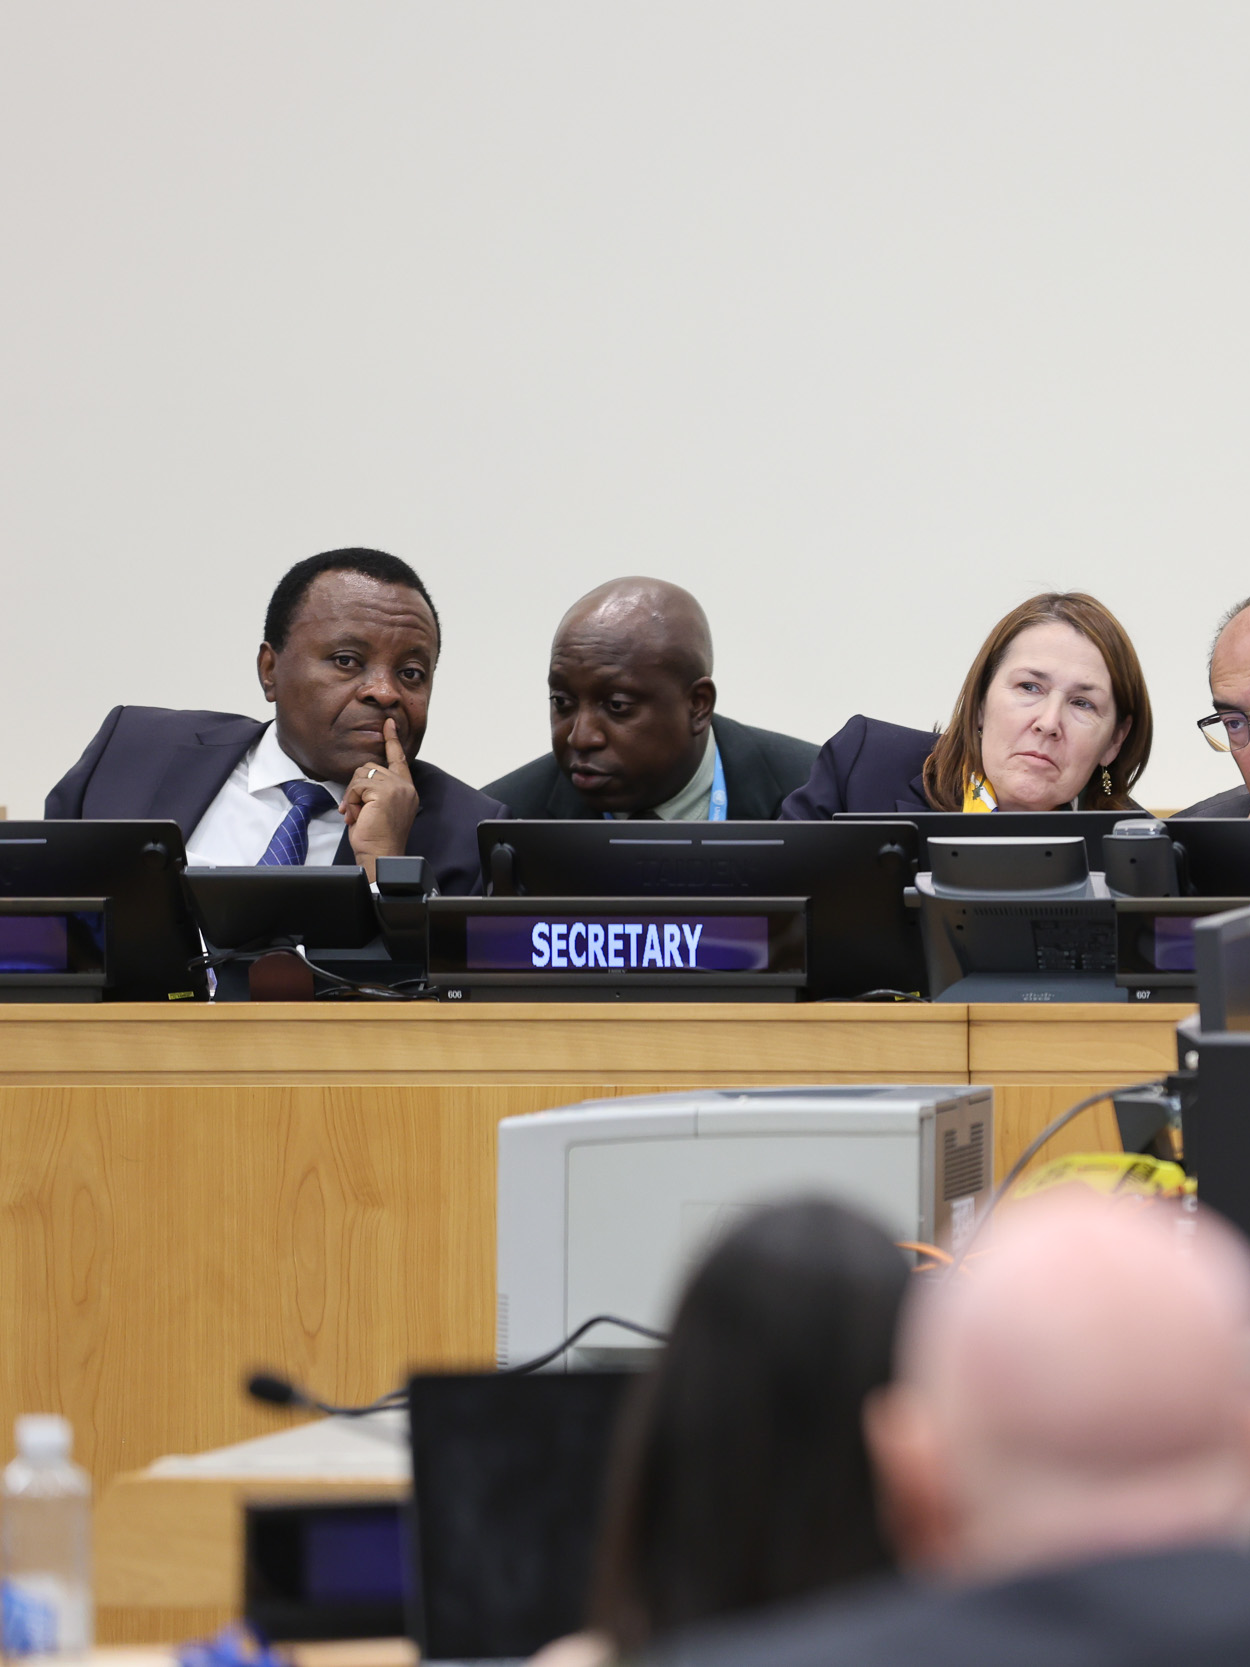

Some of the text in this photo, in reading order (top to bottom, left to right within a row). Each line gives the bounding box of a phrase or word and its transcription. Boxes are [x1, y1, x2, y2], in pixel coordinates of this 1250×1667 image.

[532, 922, 703, 968] SECRETARY
[447, 990, 462, 999] 606
[1136, 990, 1151, 999] 607
